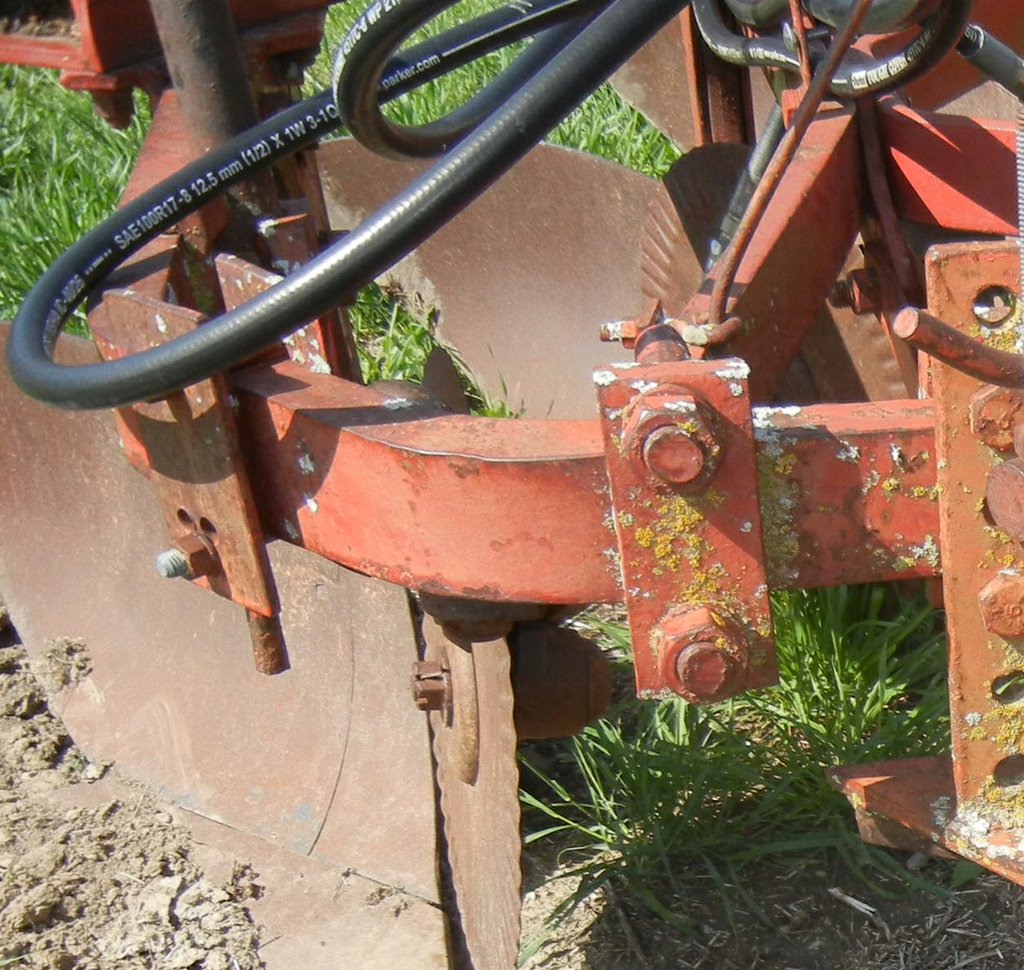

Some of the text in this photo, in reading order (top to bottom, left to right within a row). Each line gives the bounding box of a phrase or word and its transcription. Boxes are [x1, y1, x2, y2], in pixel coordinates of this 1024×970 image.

[381, 53, 441, 91] parker.com
[114, 184, 192, 250] SAE100R17-8
[218, 158, 243, 182] mm
[241, 140, 272, 168] (1/2)
[273, 135, 285, 150] X
[284, 120, 306, 141] 1W
